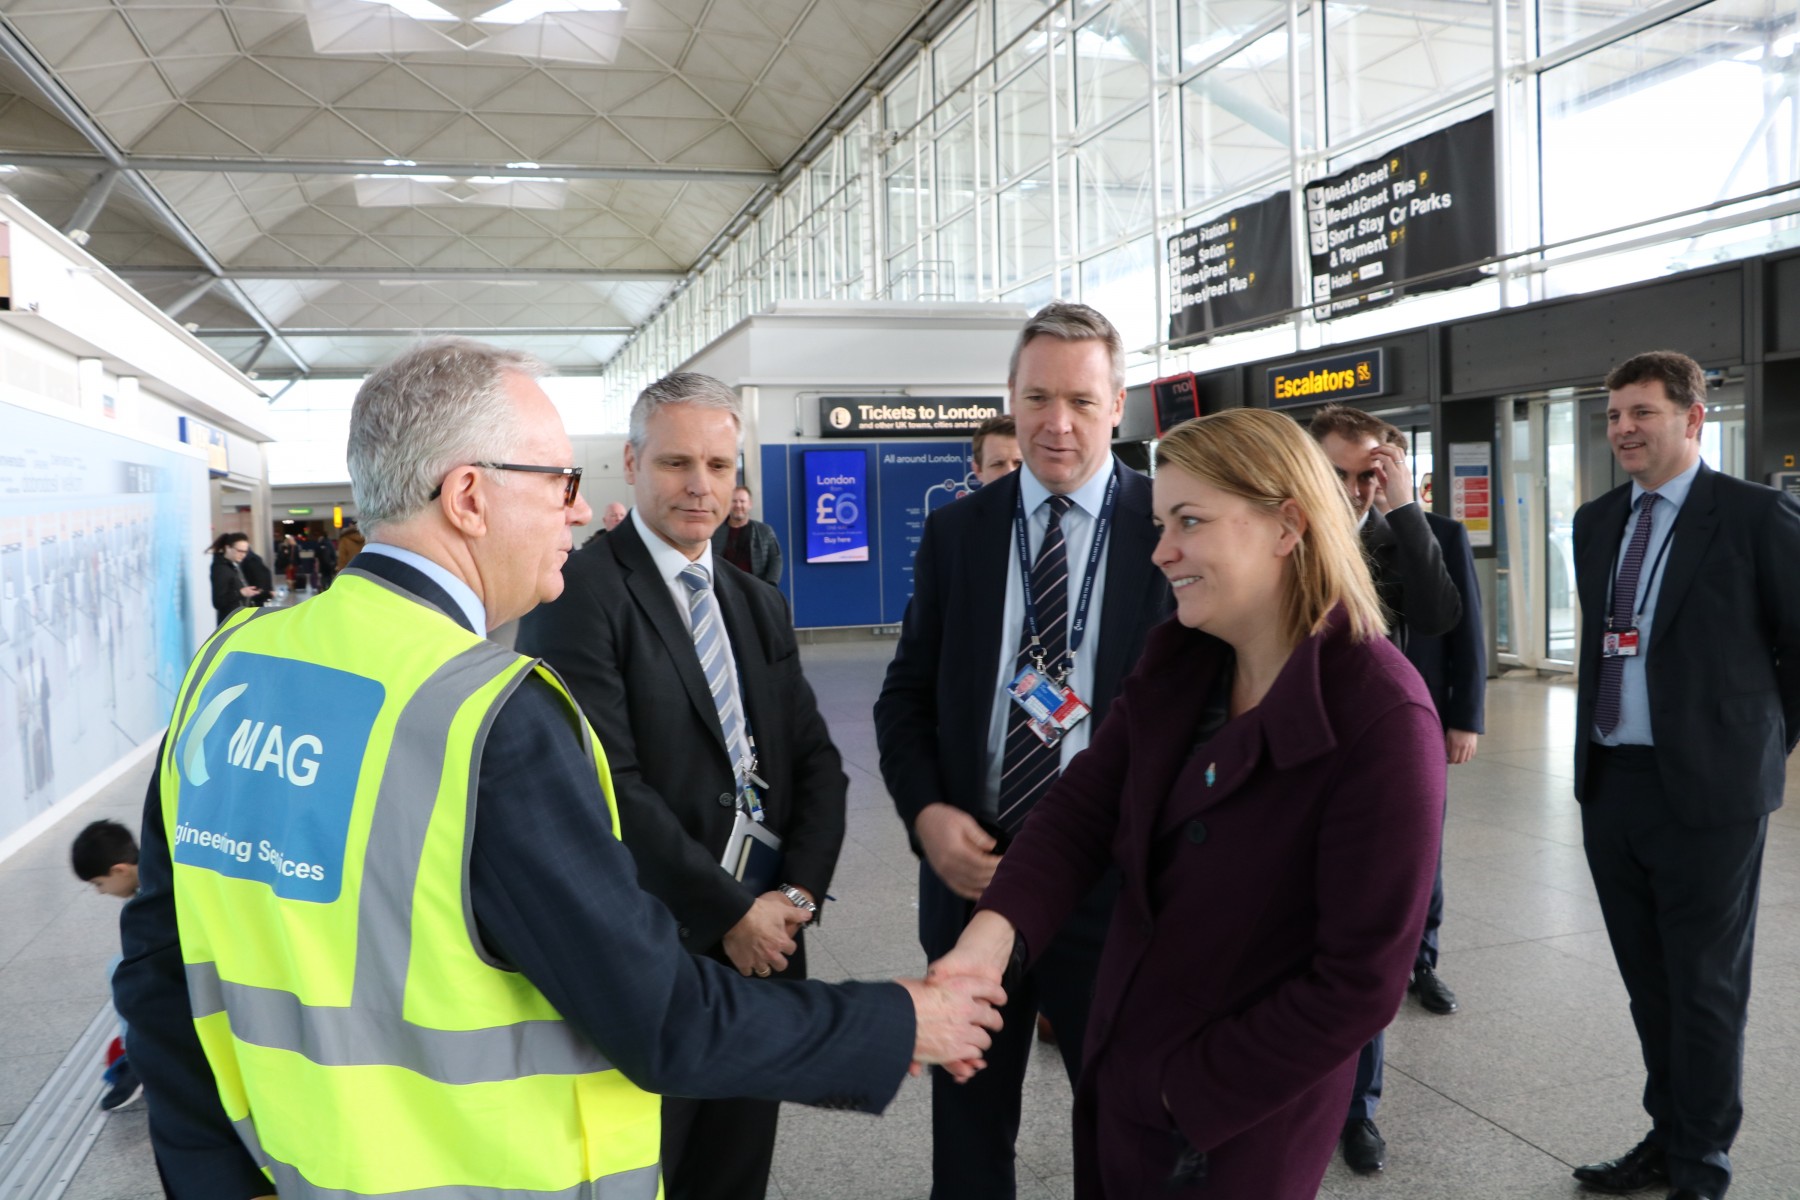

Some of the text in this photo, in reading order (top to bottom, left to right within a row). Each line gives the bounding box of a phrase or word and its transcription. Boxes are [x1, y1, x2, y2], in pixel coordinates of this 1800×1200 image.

[1325, 163, 1389, 203] Meet&Greet
[1327, 188, 1389, 225] Meet&Greet
[1357, 215, 1385, 236] Stay
[1410, 193, 1452, 217] Parks
[1199, 243, 1226, 263] Sation
[1329, 251, 1339, 268] &
[1339, 234, 1389, 264] Payment
[1229, 276, 1248, 293] Plus
[1331, 270, 1353, 290] Hotel
[1274, 368, 1355, 399] Escalators
[858, 405, 917, 420] Tickets
[919, 405, 935, 420] to
[938, 404, 997, 420] London
[954, 421, 969, 429] and
[883, 454, 895, 463] All
[896, 454, 927, 464] around
[928, 454, 963, 464] London,
[816, 474, 856, 485] London
[816, 492, 859, 525] £6
[823, 536, 836, 544] Buy
[227, 718, 324, 787] MAG
[174, 821, 325, 882] gineering Seices
